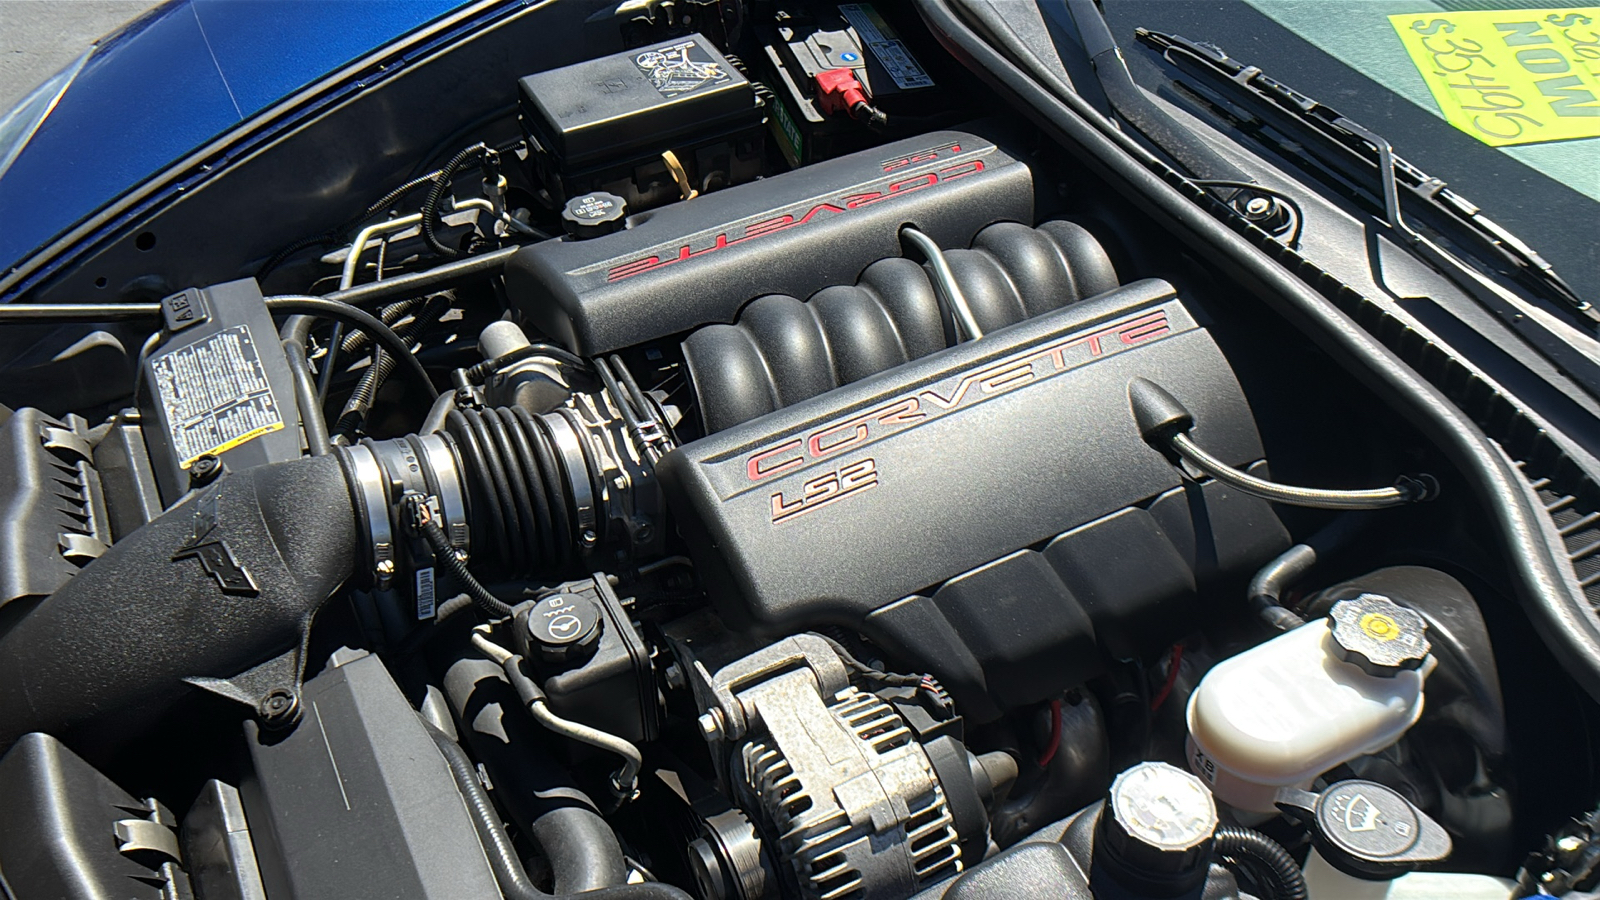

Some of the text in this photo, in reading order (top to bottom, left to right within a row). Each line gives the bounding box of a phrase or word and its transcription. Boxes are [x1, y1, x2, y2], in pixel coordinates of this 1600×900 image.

[1409, 19, 1543, 138] $35,495
[1492, 21, 1600, 117] NOW
[881, 140, 961, 172] LS2
[607, 160, 984, 283] CORVETTE
[747, 309, 1170, 481] CORVETTE
[770, 457, 878, 525] LS2
